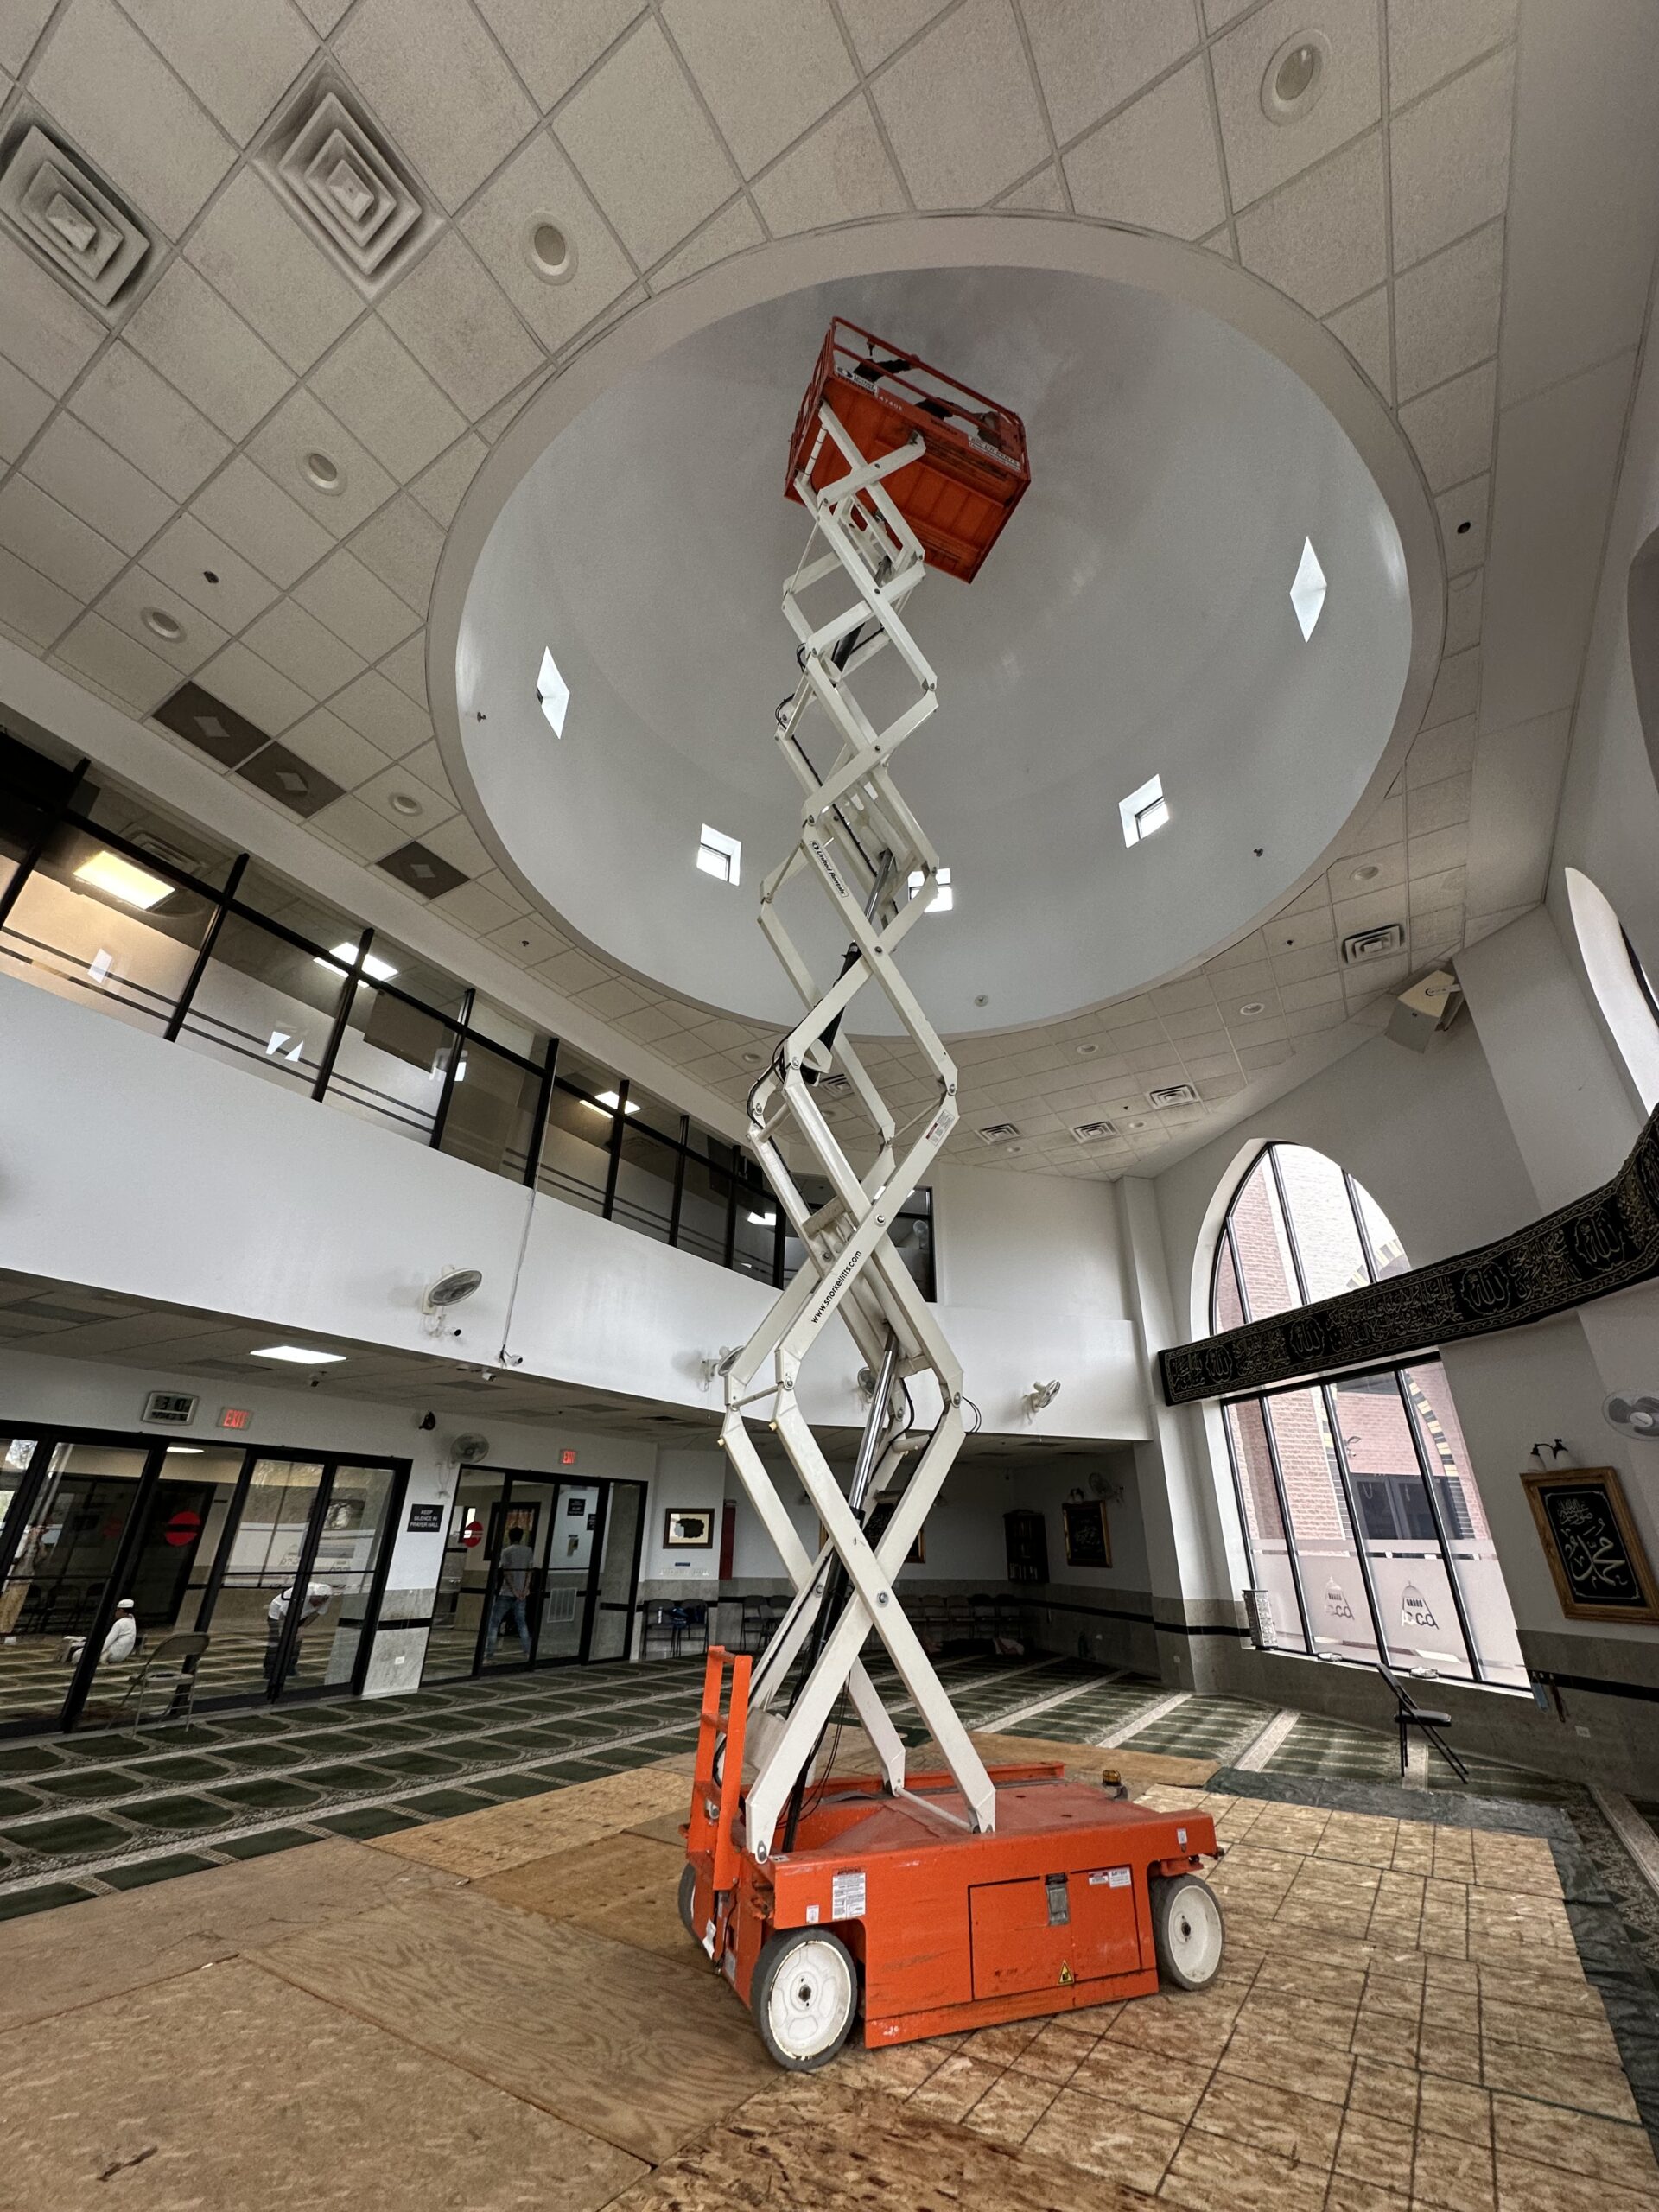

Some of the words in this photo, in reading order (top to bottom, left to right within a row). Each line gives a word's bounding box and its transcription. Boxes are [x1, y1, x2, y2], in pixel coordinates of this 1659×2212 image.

[817, 850, 833, 872] United
[829, 871, 846, 895] Rentals
[810, 1250, 862, 1324] www.snorkellifts.com
[223, 1408, 250, 1428] EXIT
